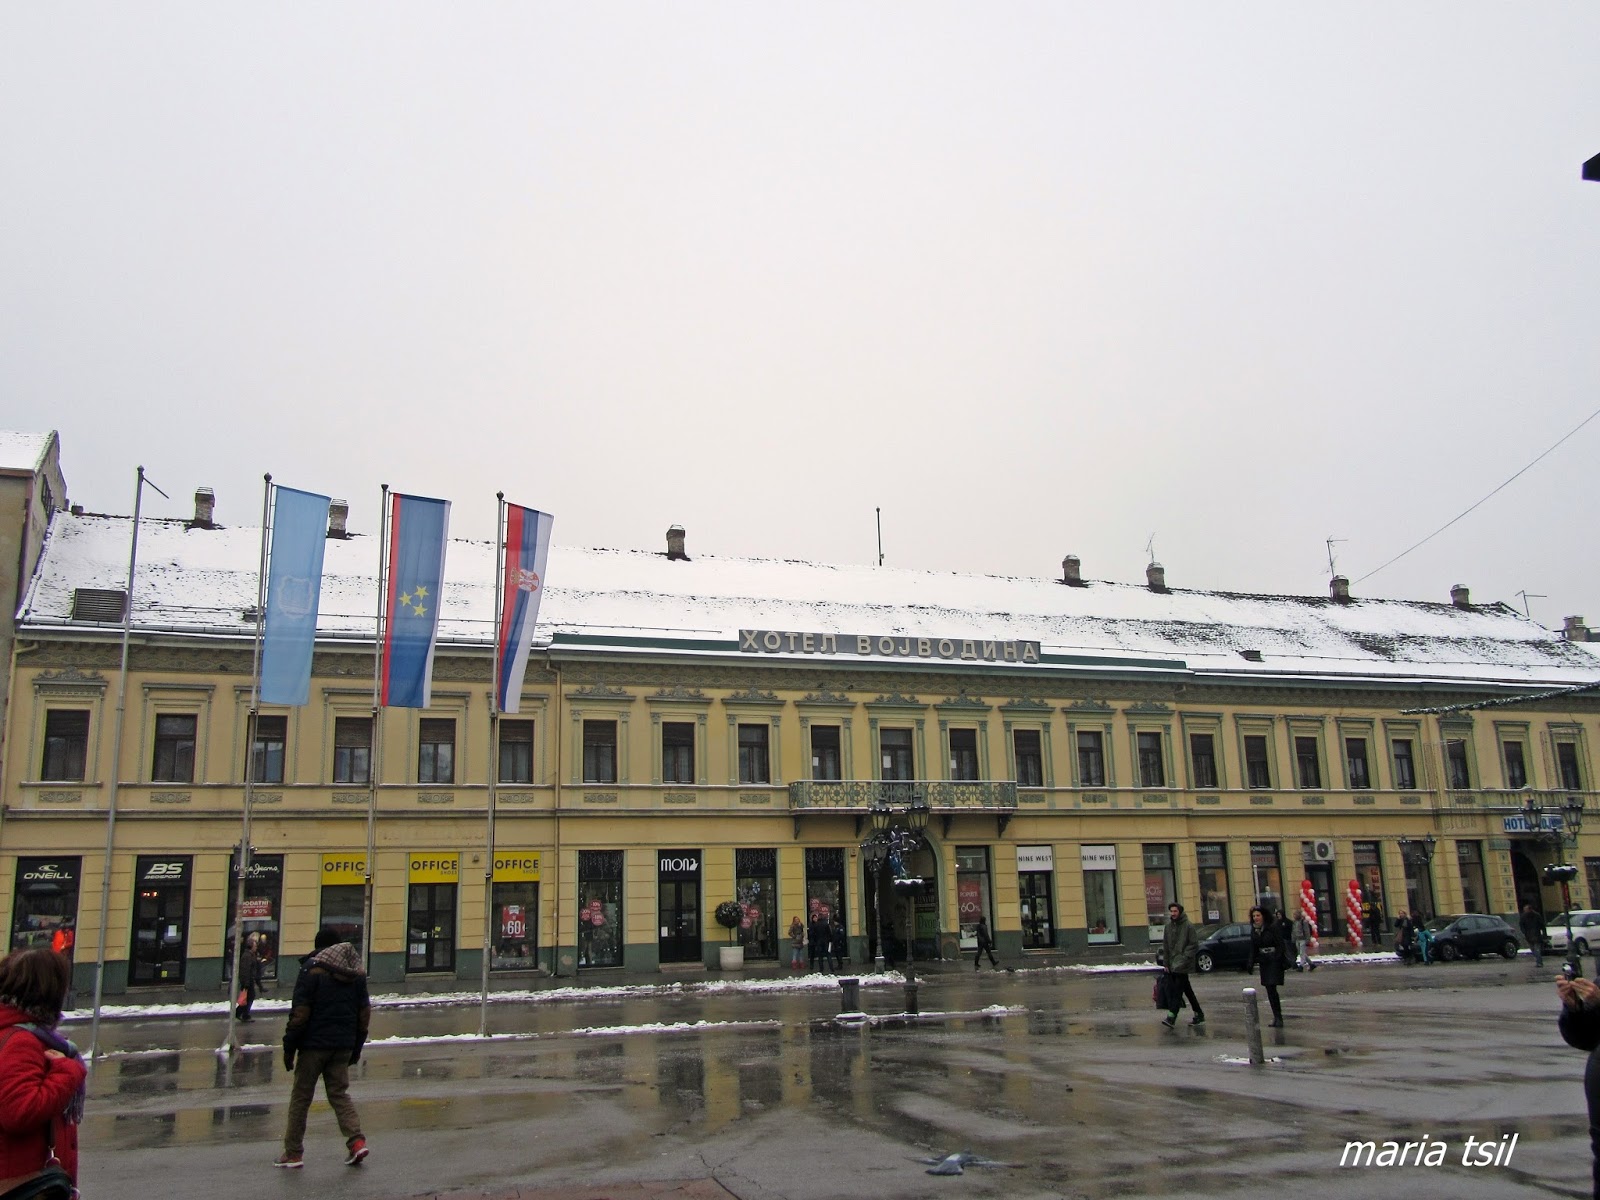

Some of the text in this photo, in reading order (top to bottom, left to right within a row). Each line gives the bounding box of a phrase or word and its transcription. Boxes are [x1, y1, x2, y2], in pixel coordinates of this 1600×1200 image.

[742, 630, 1038, 664] ХОТЕЛ ВОЈВОДИНА
[147, 863, 184, 875] BS
[324, 861, 365, 872] OFFIC
[411, 860, 457, 870] OFFICE
[495, 859, 539, 869] OFFICE
[23, 872, 73, 880] O'NEILL
[507, 920, 521, 935] 60
